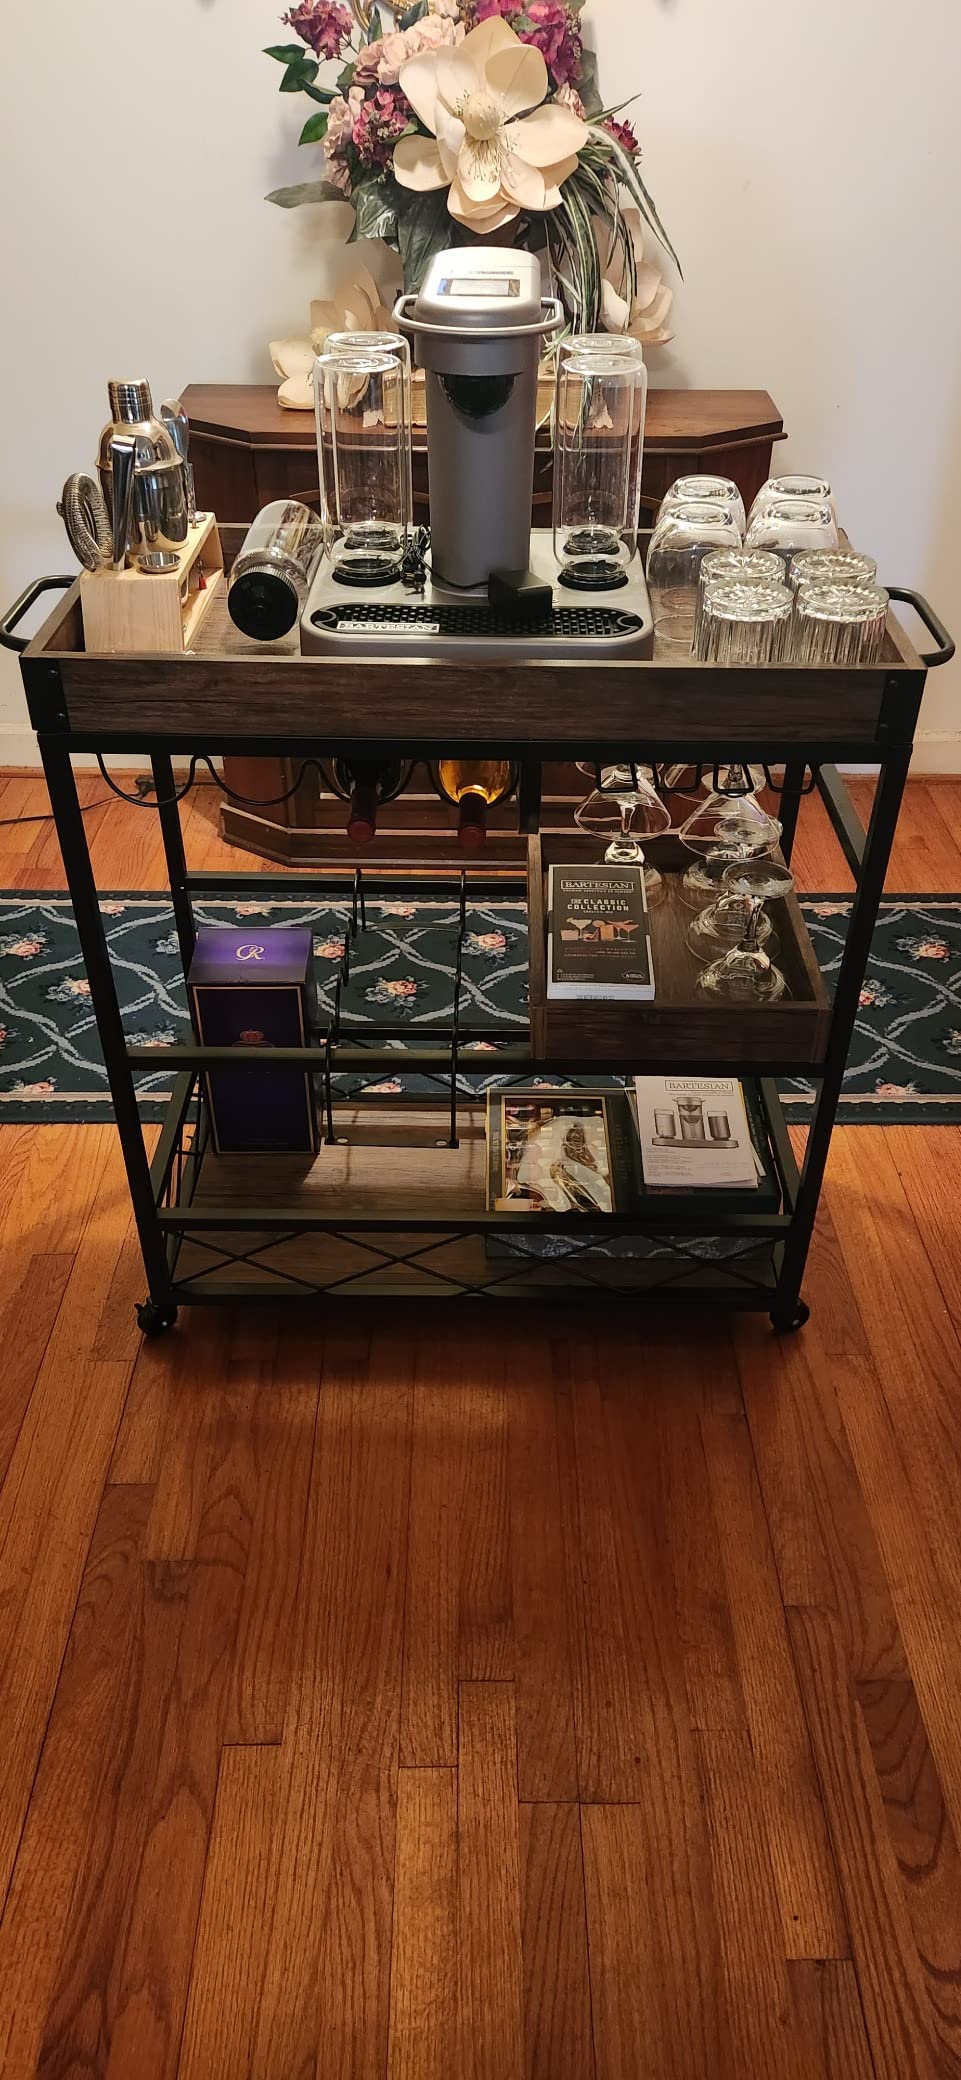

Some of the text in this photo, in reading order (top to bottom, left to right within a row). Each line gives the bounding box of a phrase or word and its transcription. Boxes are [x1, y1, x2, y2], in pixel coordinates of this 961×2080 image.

[345, 623, 432, 631] BARTESIAN
[565, 881, 629, 889] BARTESIAN
[583, 898, 626, 906] CLASSIC
[567, 904, 629, 912] COLLECTION
[668, 1082, 729, 1090] BARTESIAN
